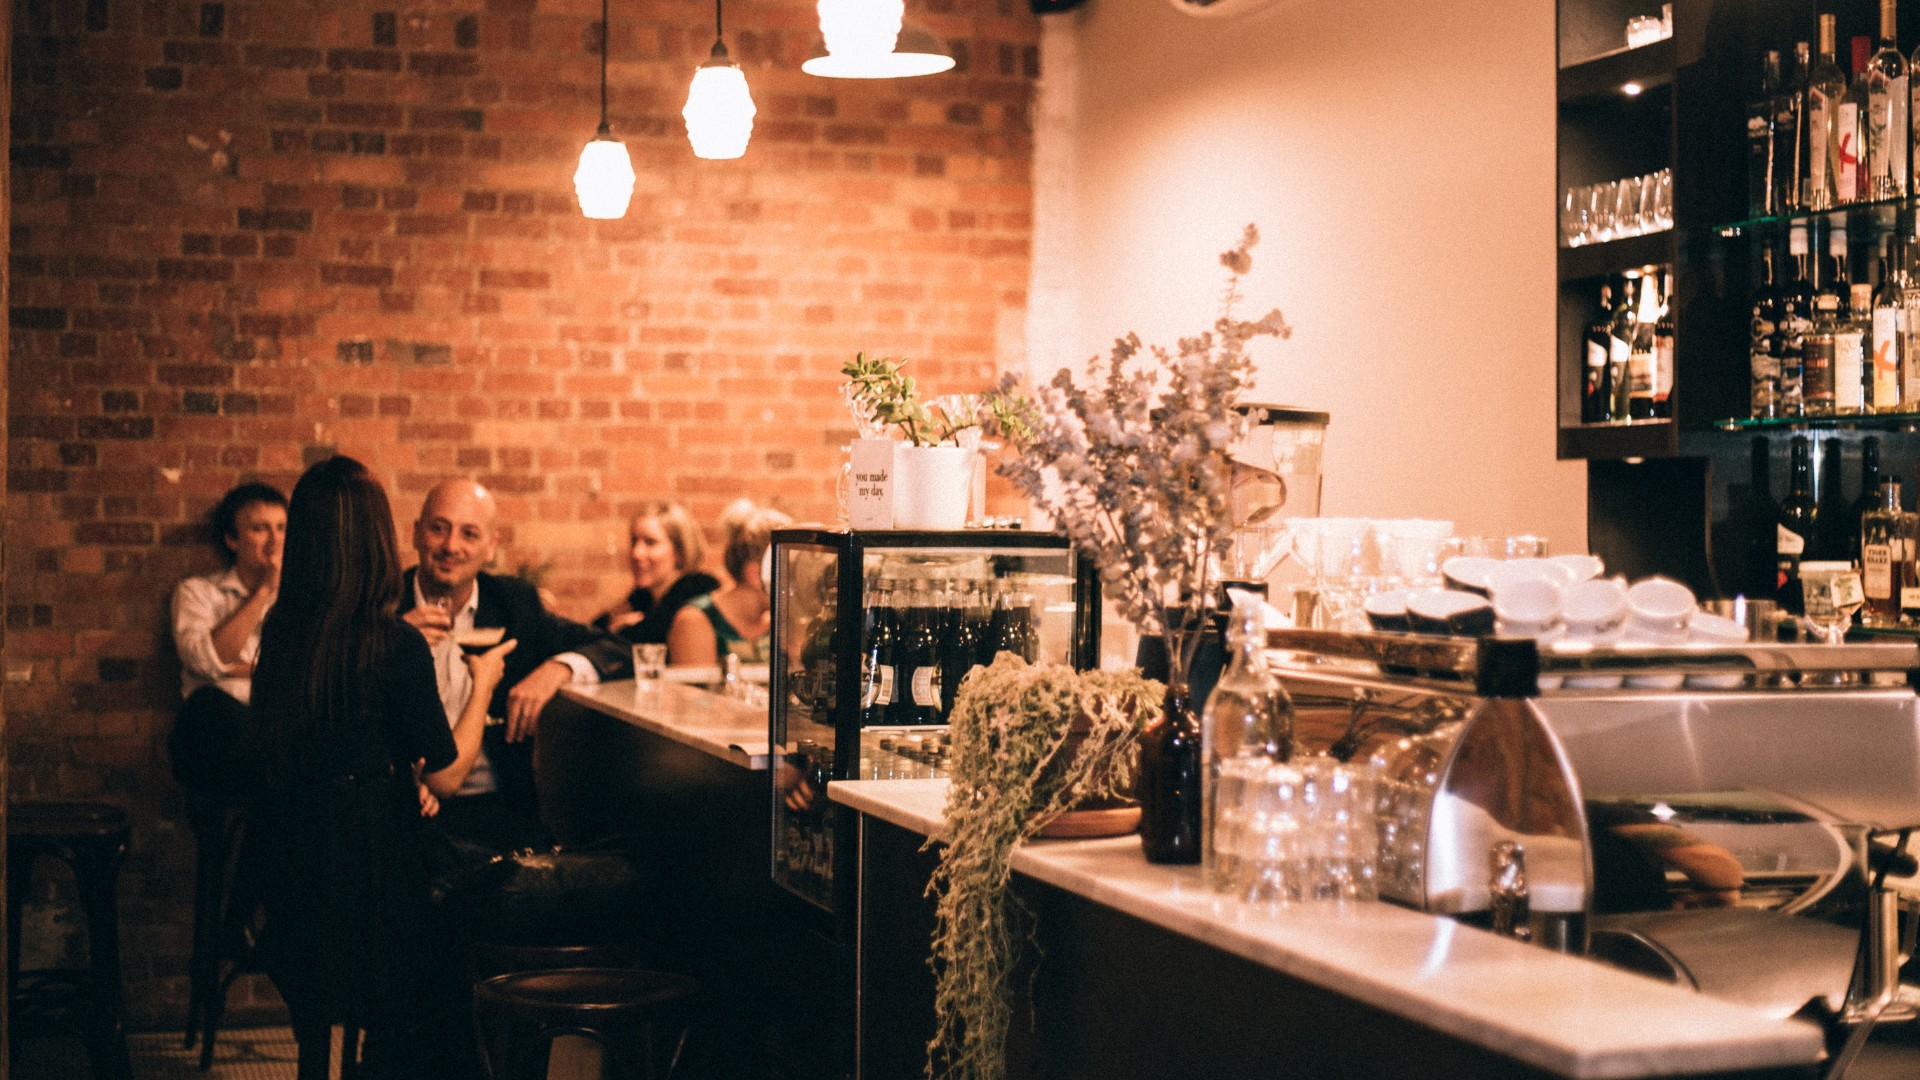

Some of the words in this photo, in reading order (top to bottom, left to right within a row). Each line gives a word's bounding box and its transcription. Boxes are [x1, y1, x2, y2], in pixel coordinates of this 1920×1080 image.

[855, 473, 868, 486] you
[869, 469, 888, 482] made
[859, 487, 869, 500] my
